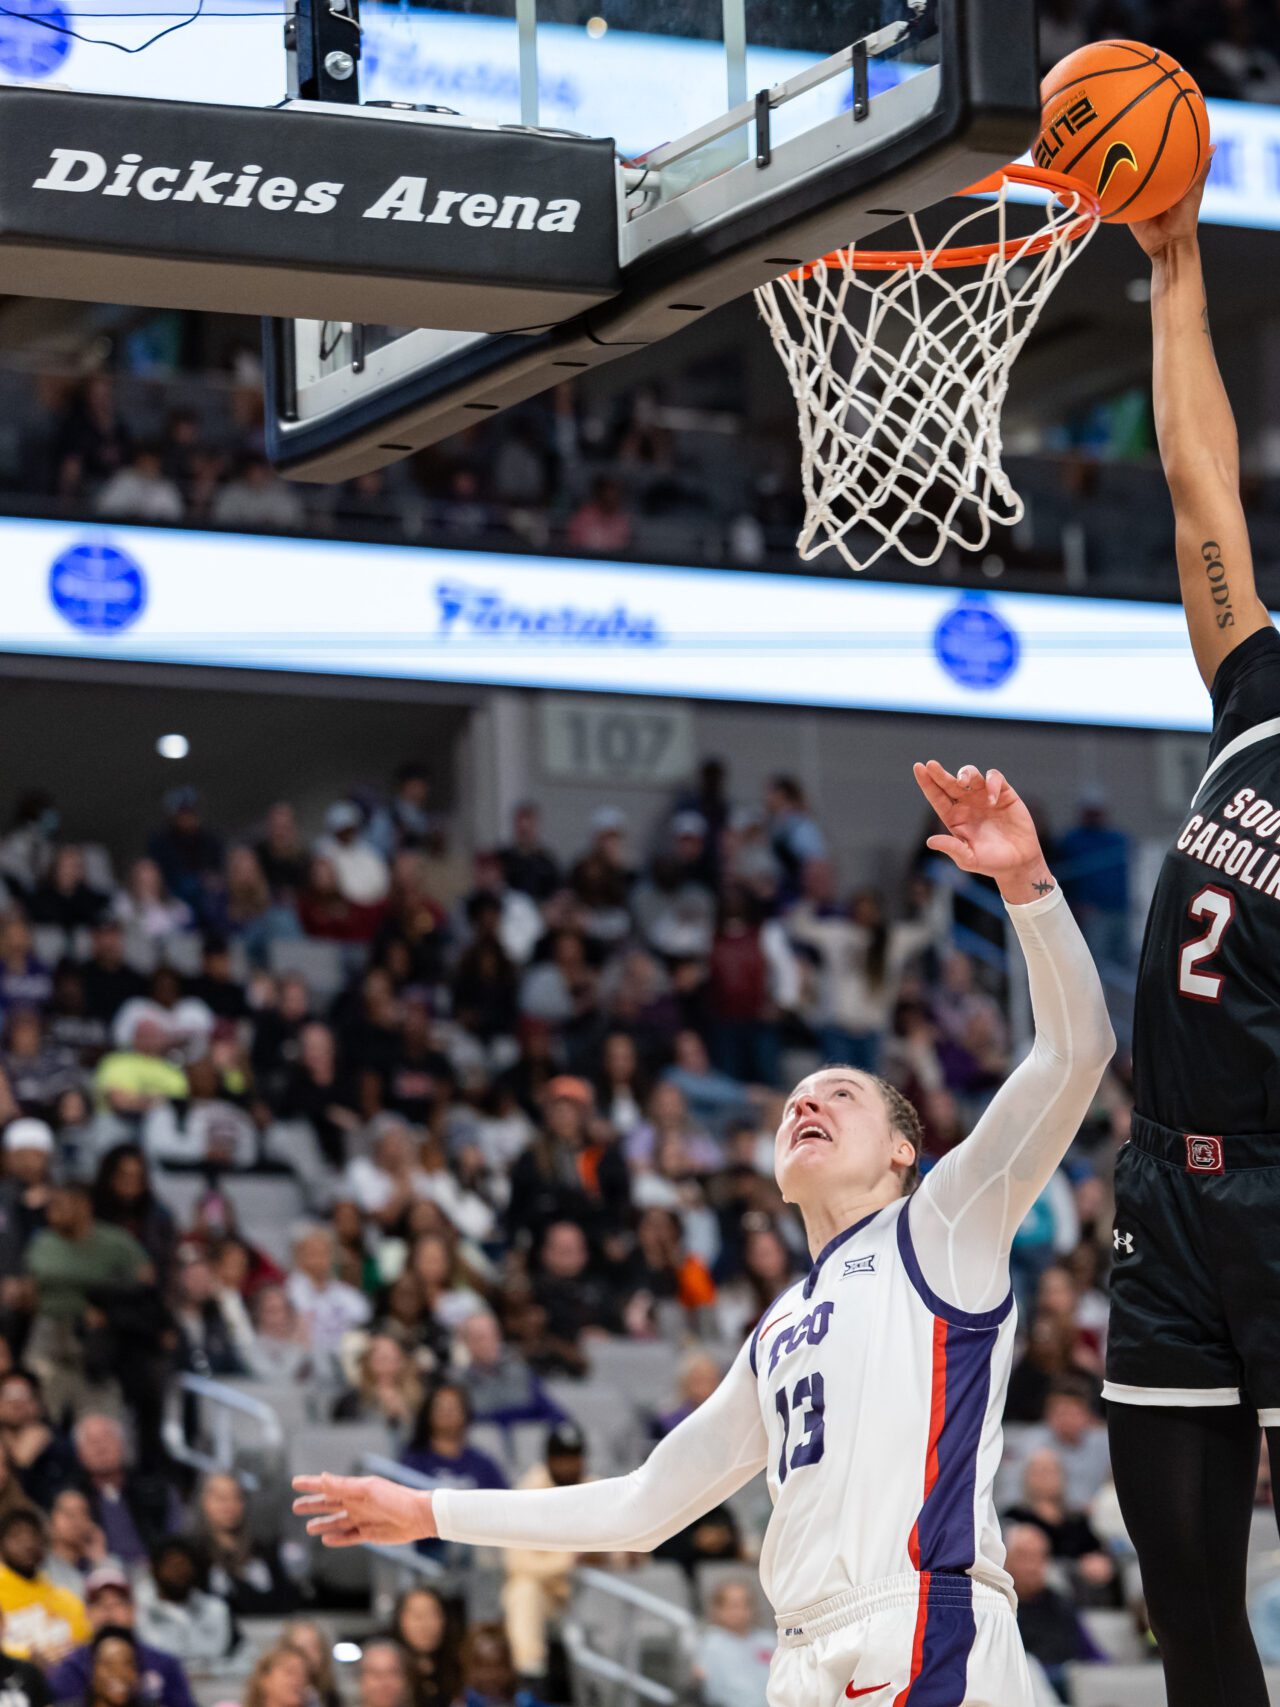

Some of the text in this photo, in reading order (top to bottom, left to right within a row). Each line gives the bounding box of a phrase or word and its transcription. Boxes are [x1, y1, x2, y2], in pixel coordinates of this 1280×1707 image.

[1034, 96, 1099, 170] ELITE
[32, 148, 582, 233] Dickies Arena
[1201, 540, 1235, 630] GOD'S
[566, 710, 676, 778] 107
[1178, 883, 1235, 1004] 2
[768, 1301, 835, 1381] TCU
[776, 1371, 825, 1485] 13
